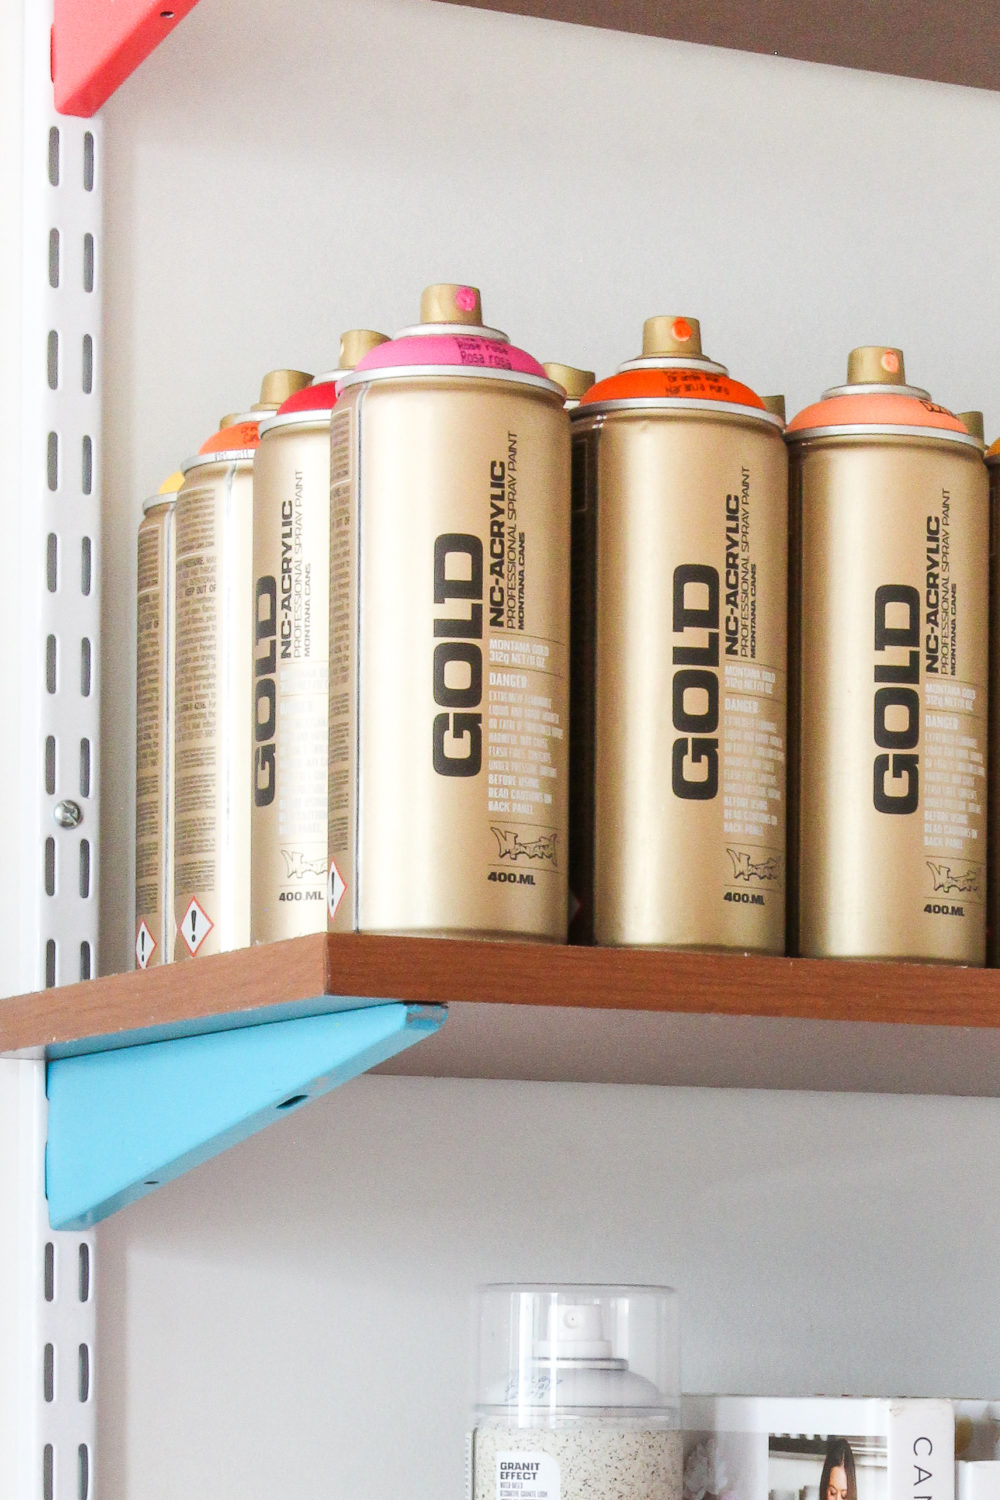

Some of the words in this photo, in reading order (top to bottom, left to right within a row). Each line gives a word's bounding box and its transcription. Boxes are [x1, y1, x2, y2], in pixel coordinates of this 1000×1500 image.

[508, 431, 517, 471] PAINT
[508, 474, 517, 521] SPRAY
[742, 466, 750, 505] PAINT
[489, 460, 506, 627] NC-ACRYLIC
[942, 488, 950, 526] PAINT
[281, 500, 293, 659] NC-ACRYLIC
[507, 524, 517, 629] PROFESSIONAL
[725, 494, 739, 656] NC-ACRYLIC
[741, 556, 749, 657] PROFESSIONAL
[926, 516, 940, 673] NC-ACRYLIC
[433, 533, 483, 777] GOLD
[941, 578, 949, 675] PROFESSIONAL
[254, 575, 276, 807] GOLD
[672, 564, 720, 800] GOLD
[873, 584, 920, 815] GOLD
[487, 872, 536, 886] 400.ML
[724, 889, 765, 906] 400.ML
[924, 904, 965, 917] 400.ML
[500, 1462, 540, 1471] GRANIT
[500, 1472, 538, 1480] EFFECT
